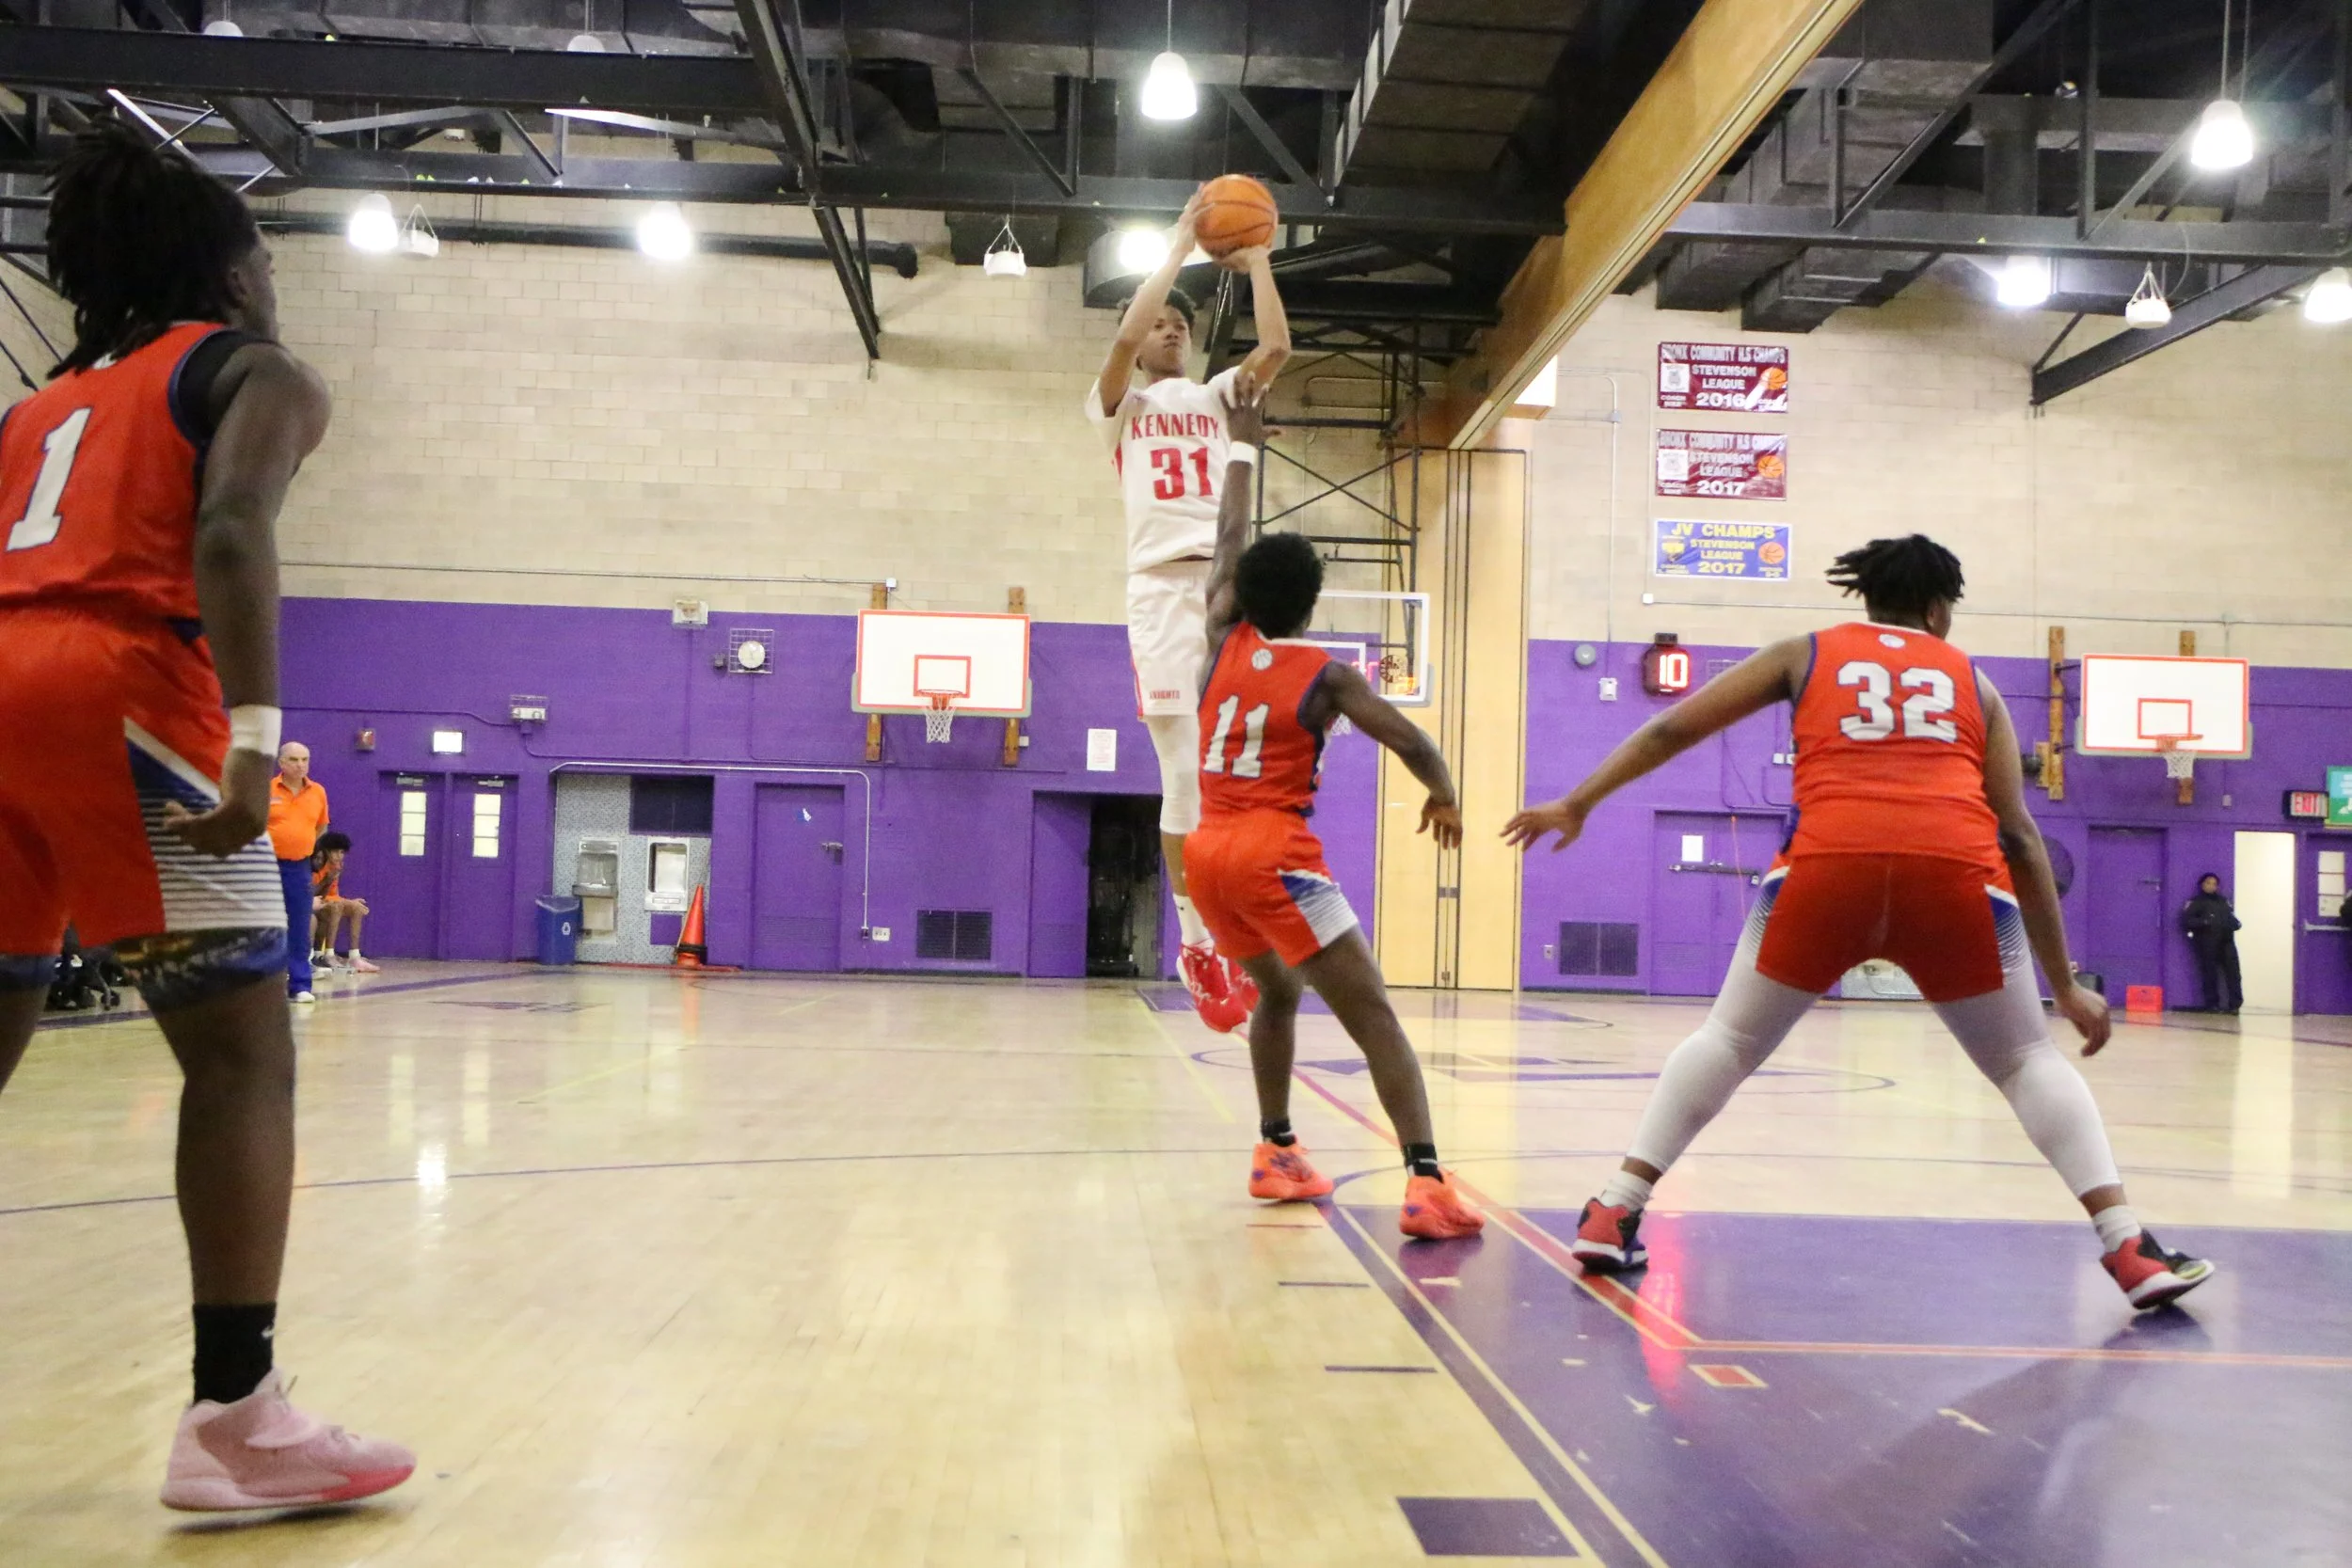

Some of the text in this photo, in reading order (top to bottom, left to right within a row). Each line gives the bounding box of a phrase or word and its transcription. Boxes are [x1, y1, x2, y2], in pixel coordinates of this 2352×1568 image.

[1692, 364, 1756, 376] STEVENSON
[1702, 378, 1745, 389] LEAGUE
[1695, 392, 1746, 408] 2016
[1132, 413, 1218, 440] KENNEDY
[1690, 451, 1755, 465] STEVENSON
[6, 407, 91, 551] 1
[1150, 446, 1214, 500] 31
[1699, 465, 1742, 477] LEAGUE
[1696, 480, 1746, 496] 2017
[1671, 523, 1775, 539] JV CHAMPS
[1690, 539, 1756, 550] STEVENSON
[1700, 550, 1743, 561] LEAGUE
[1697, 562, 1746, 574] 2017
[1659, 653, 1689, 688] 10
[1837, 661, 1958, 744] 32
[1202, 694, 1269, 779] 11
